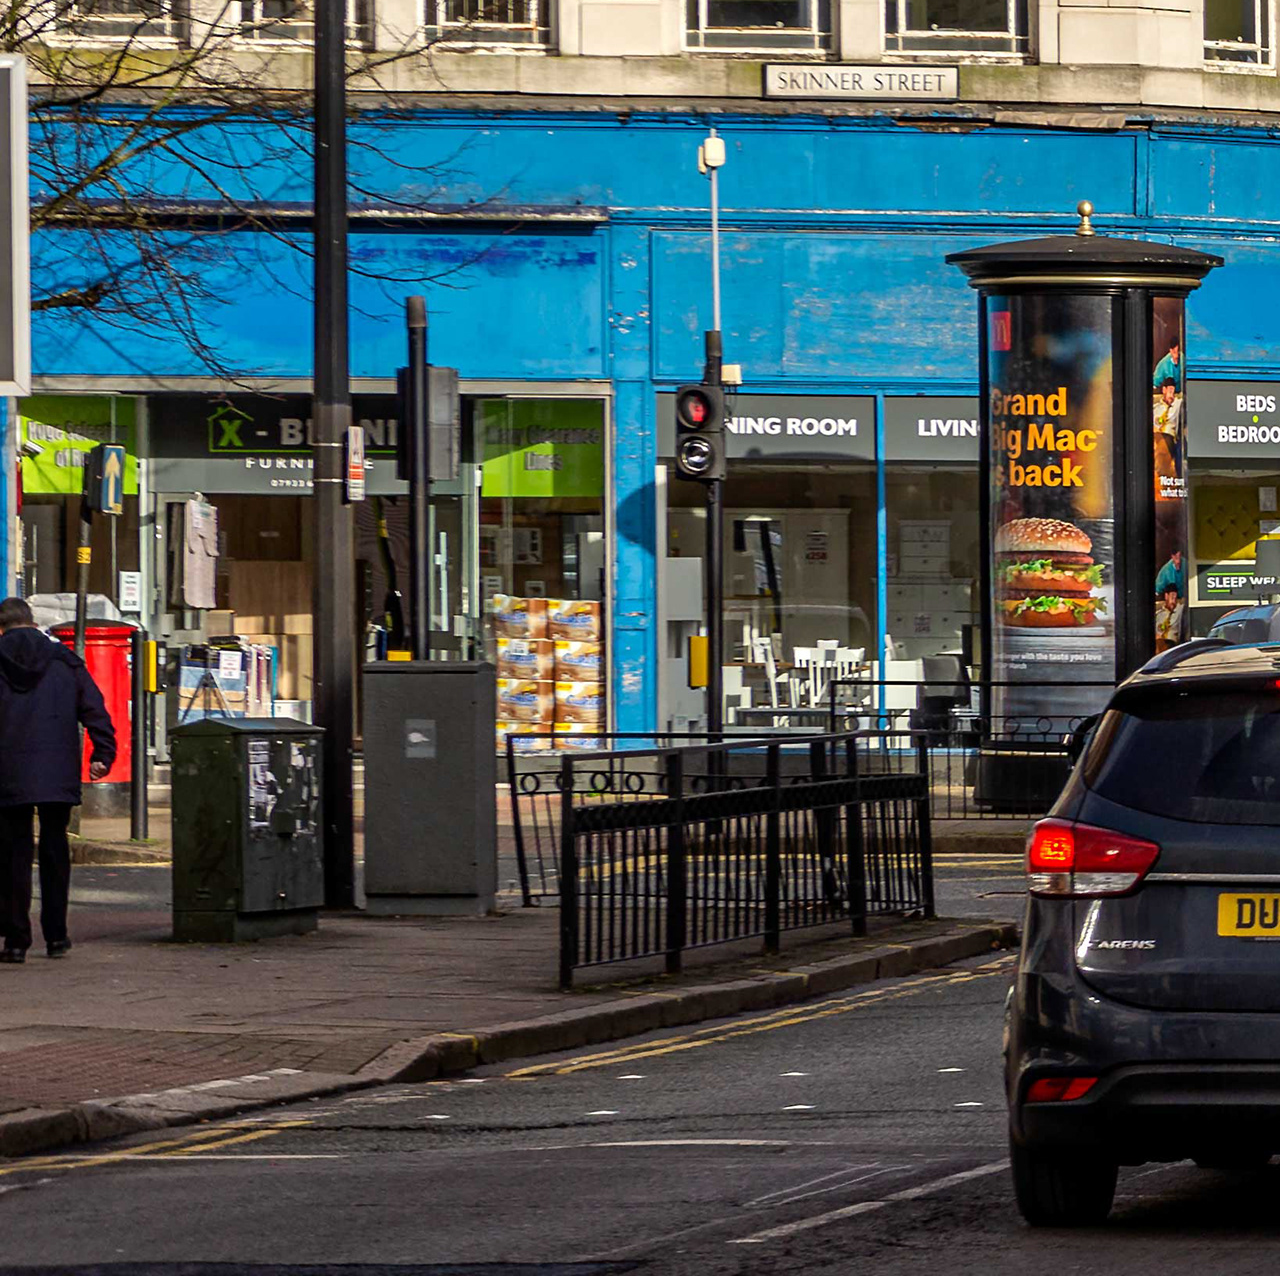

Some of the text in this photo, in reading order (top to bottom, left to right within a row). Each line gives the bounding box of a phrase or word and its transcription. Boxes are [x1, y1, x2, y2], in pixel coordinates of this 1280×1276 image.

[778, 72, 946, 92] SKINNER STREET
[1236, 395, 1276, 412] BEDS
[219, 420, 244, 447] X
[786, 418, 857, 436] ROOM
[918, 419, 980, 437] LIVIN
[245, 456, 374, 470] FURNIE
[1010, 458, 1084, 487] back
[1207, 577, 1247, 588] SLEEP
